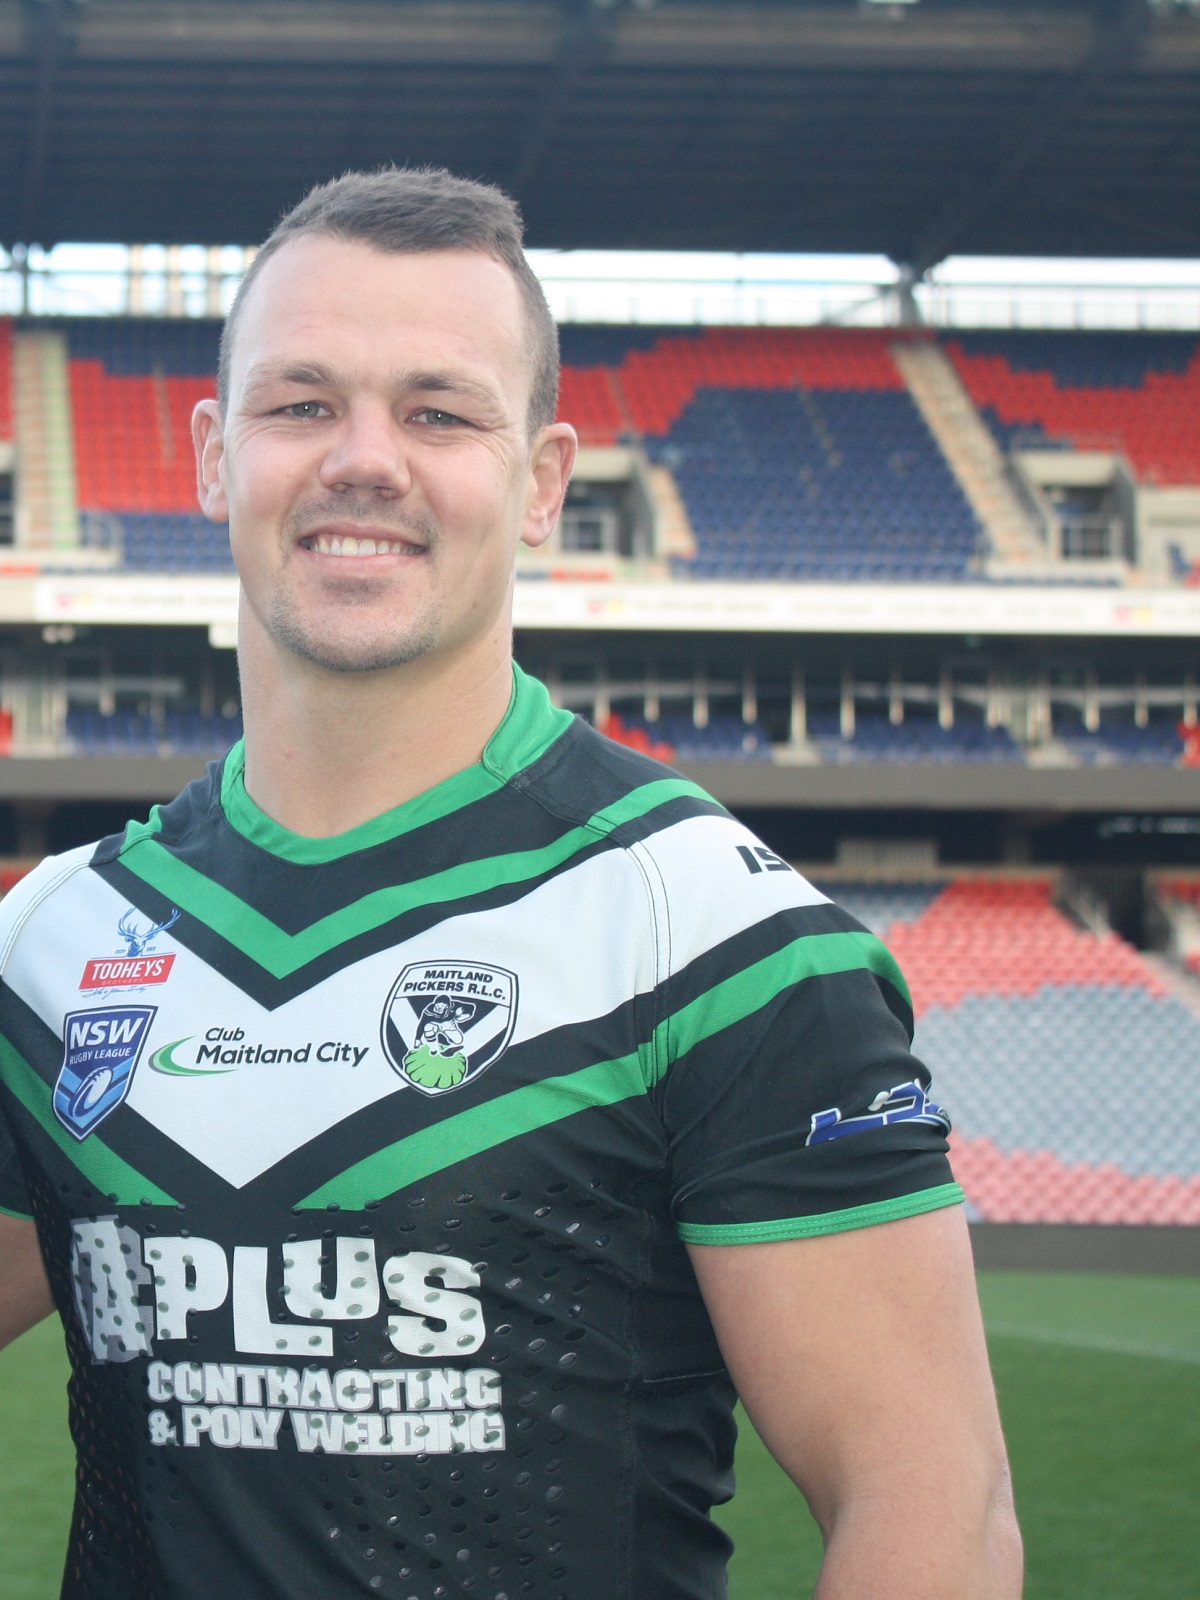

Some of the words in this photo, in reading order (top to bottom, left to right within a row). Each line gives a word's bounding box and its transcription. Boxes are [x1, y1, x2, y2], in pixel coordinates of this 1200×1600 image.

[91, 959, 165, 981] TOOHEYS
[424, 970, 493, 984] MAITLAND
[403, 981, 465, 993] PICKERS
[467, 983, 506, 1001] R.L.C.
[69, 1016, 145, 1050] NSW
[205, 1027, 246, 1042] Club
[69, 1051, 92, 1066] RUGBY
[94, 1047, 132, 1060] LEAGUE
[195, 1043, 312, 1065] Maitland
[316, 1041, 370, 1068] City
[146, 1360, 502, 1412] CONTRACTING
[147, 1408, 180, 1448] &
[181, 1405, 287, 1452] POLY
[289, 1407, 507, 1457] WELDING
